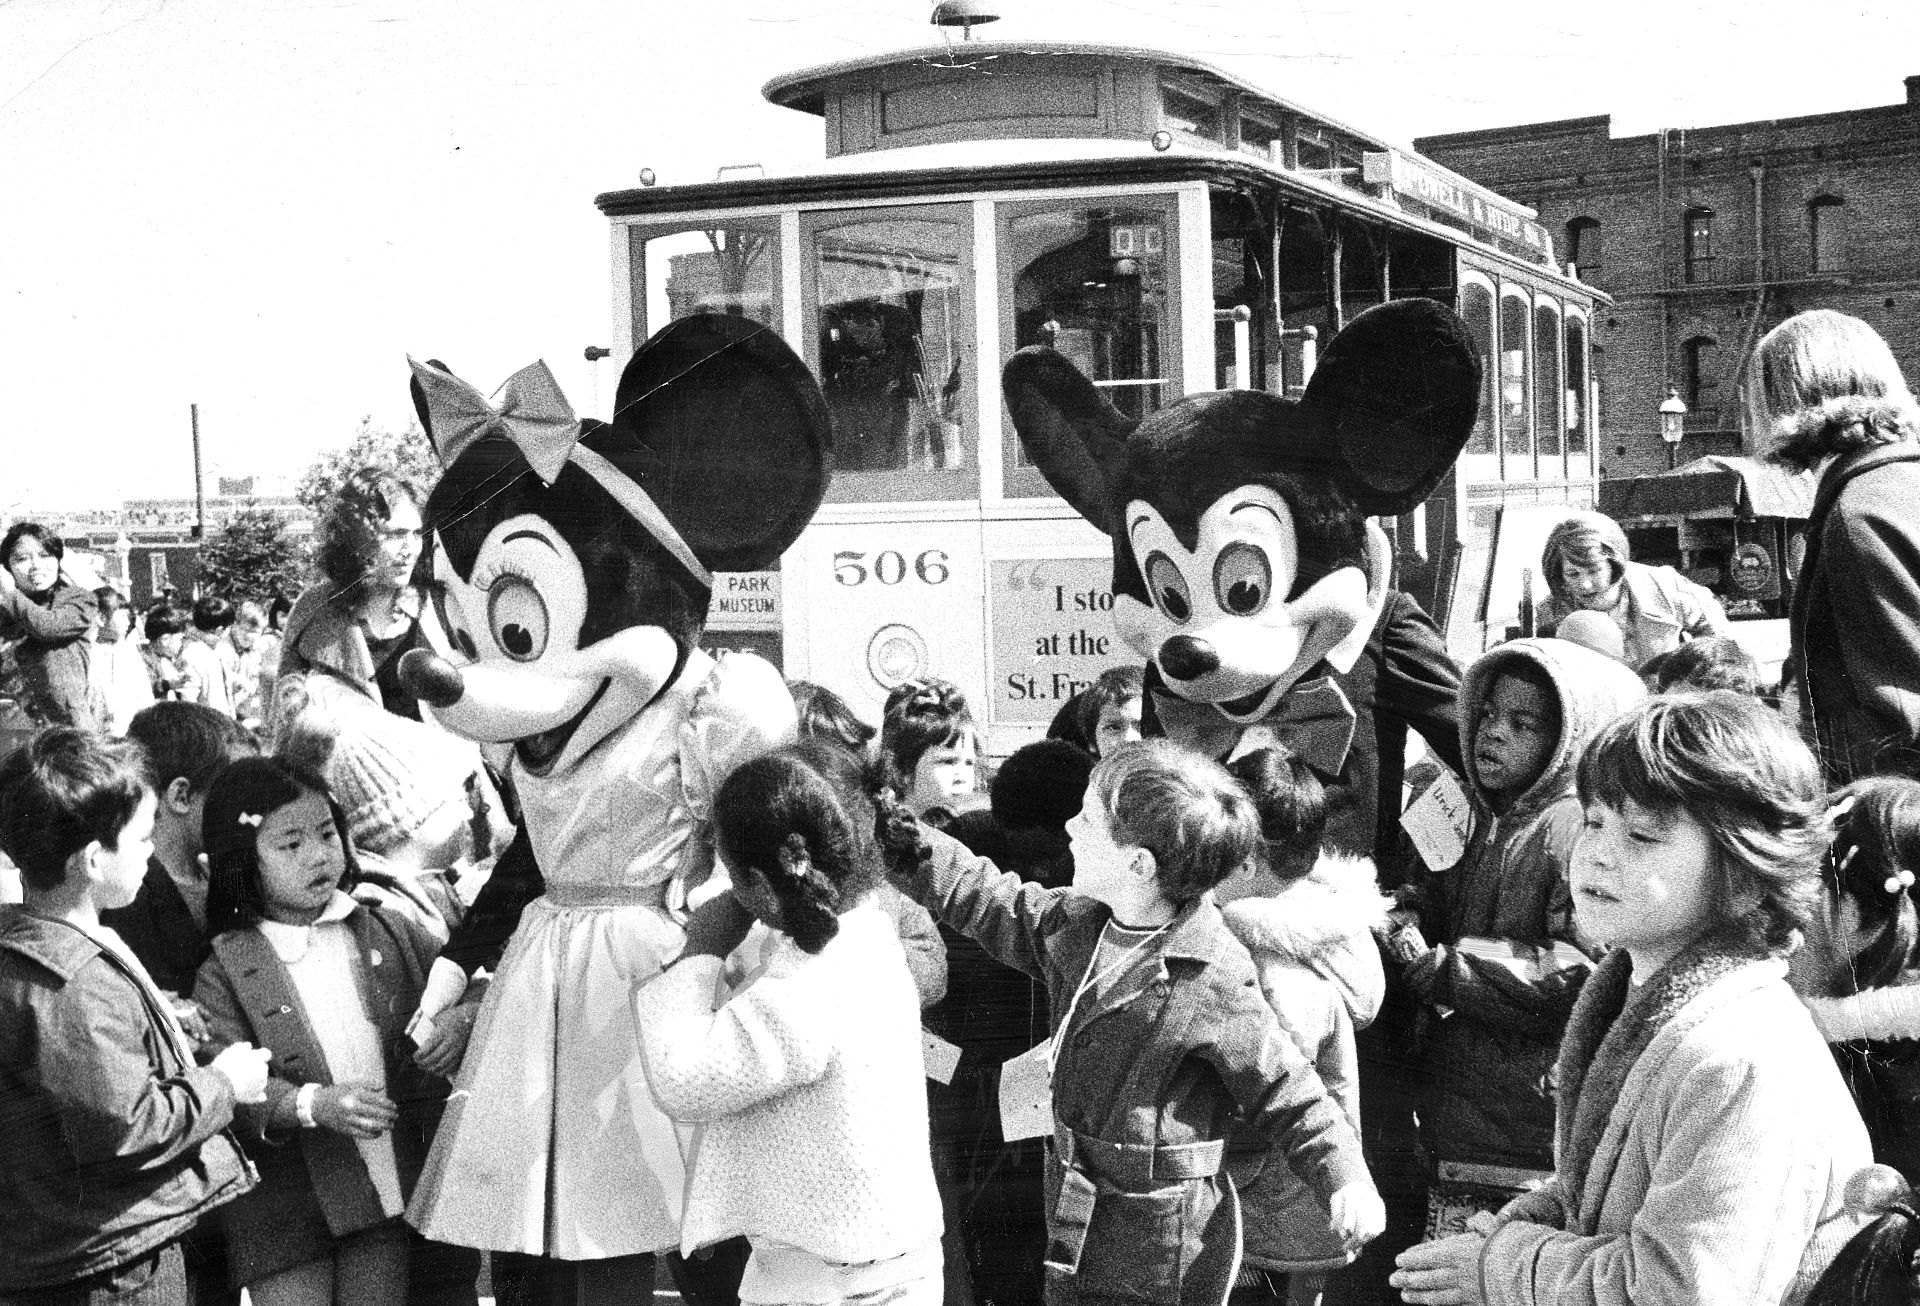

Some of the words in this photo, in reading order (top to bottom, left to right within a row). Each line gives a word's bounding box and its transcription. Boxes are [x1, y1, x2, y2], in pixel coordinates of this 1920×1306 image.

[833, 549, 950, 587] 506
[728, 577, 771, 591] PARK
[718, 598, 775, 613] MUSEUM
[1055, 586, 1066, 612] I
[1074, 587, 1114, 612] sto
[1035, 632, 1060, 656] at
[1068, 629, 1110, 656] the
[1007, 672, 1047, 701] St.
[1051, 673, 1093, 700] Fr
